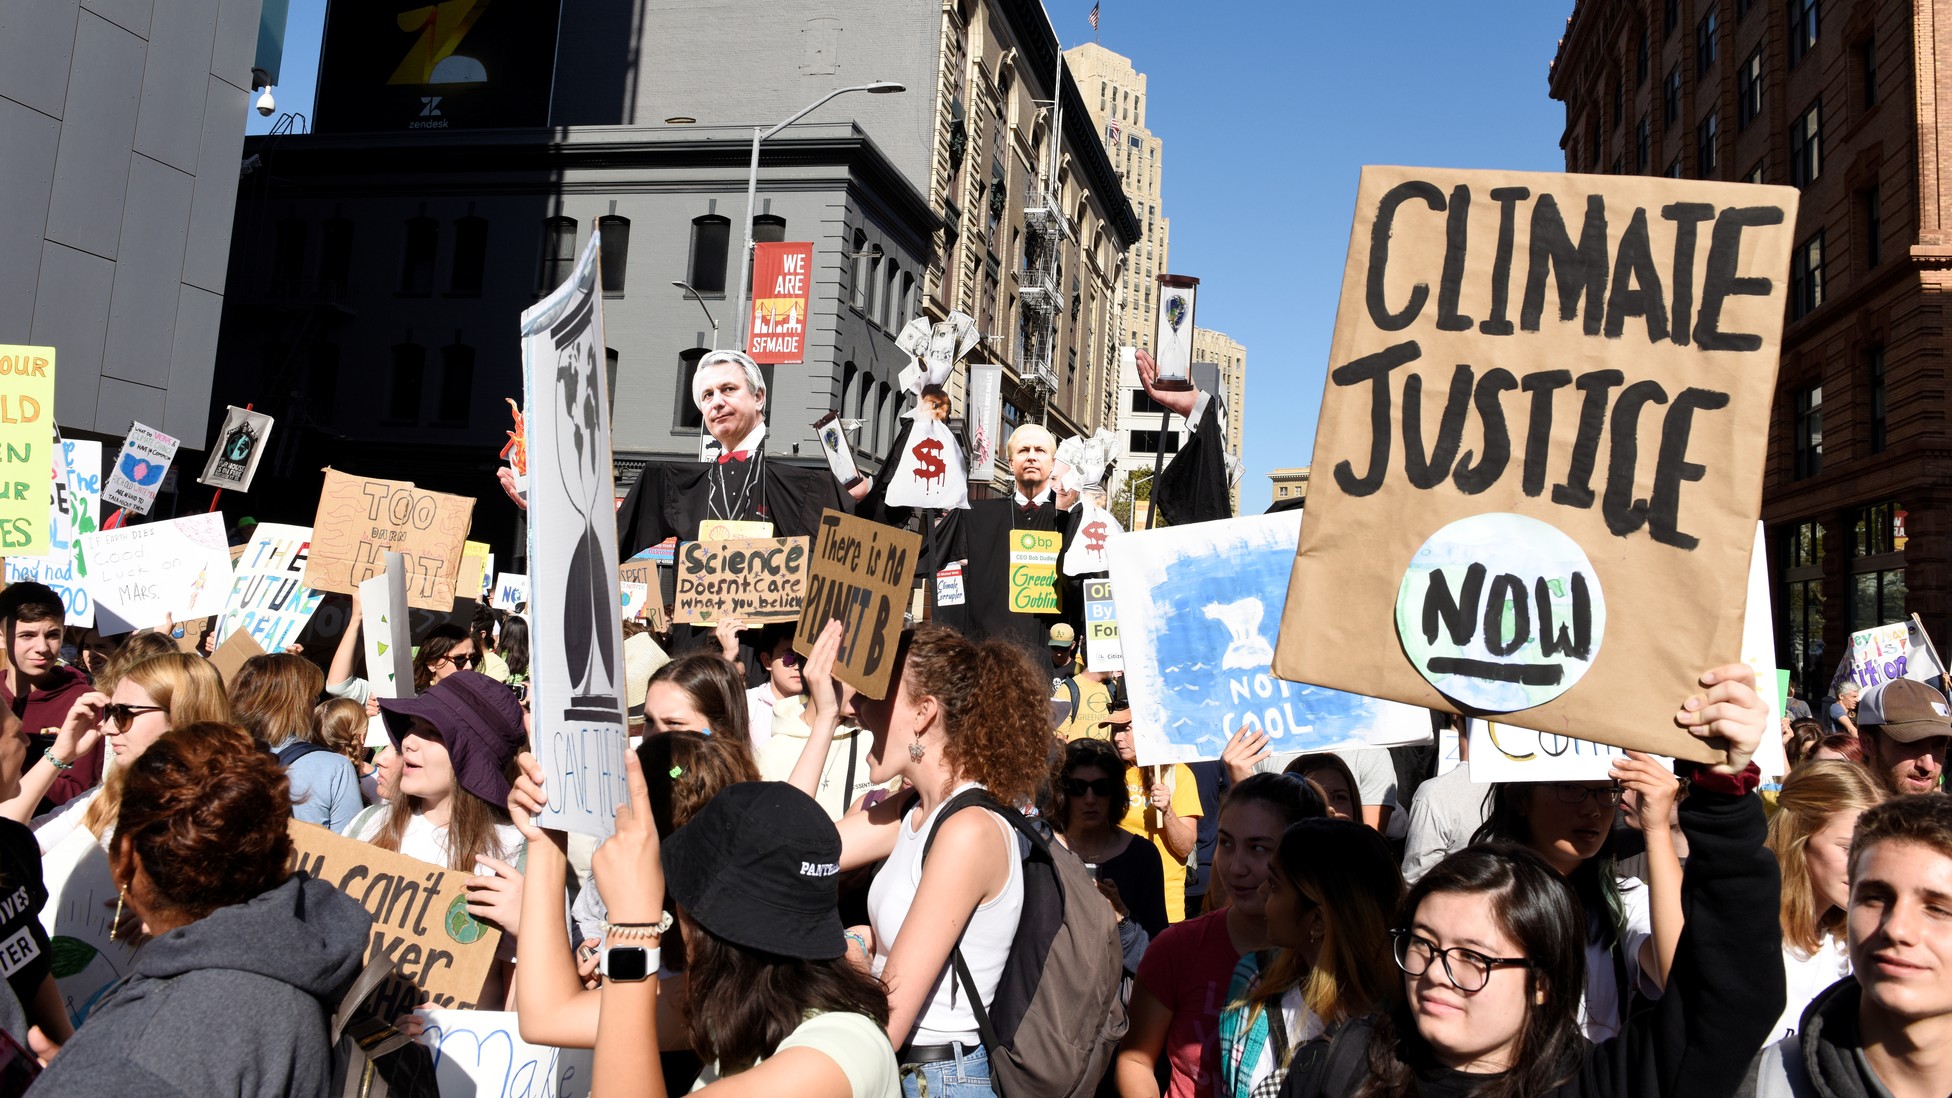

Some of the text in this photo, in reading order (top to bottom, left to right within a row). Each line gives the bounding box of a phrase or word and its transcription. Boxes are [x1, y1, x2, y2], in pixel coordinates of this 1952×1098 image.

[409, 119, 449, 128] zendesk
[783, 254, 806, 273] WE
[1366, 180, 1784, 352] CLIMATE
[774, 275, 804, 295] ARE
[752, 337, 800, 353] SFMADE
[1331, 340, 1730, 551] JUSTICE
[363, 482, 437, 530] TOO
[132, 528, 155, 539] DIES
[371, 527, 407, 542] DARN
[1038, 536, 1052, 550] bp
[251, 539, 311, 572] THE
[685, 543, 804, 577] Science
[822, 515, 907, 587] There is no
[732, 597, 753, 614] you
[758, 592, 804, 609] believ
[1015, 587, 1057, 609] Goblin
[1092, 604, 1113, 620] By
[1421, 561, 1592, 661] NOW
[863, 594, 890, 677] B
[1222, 702, 1314, 741] COOL
[545, 728, 592, 816] SAVE
[337, 864, 445, 937] can't
